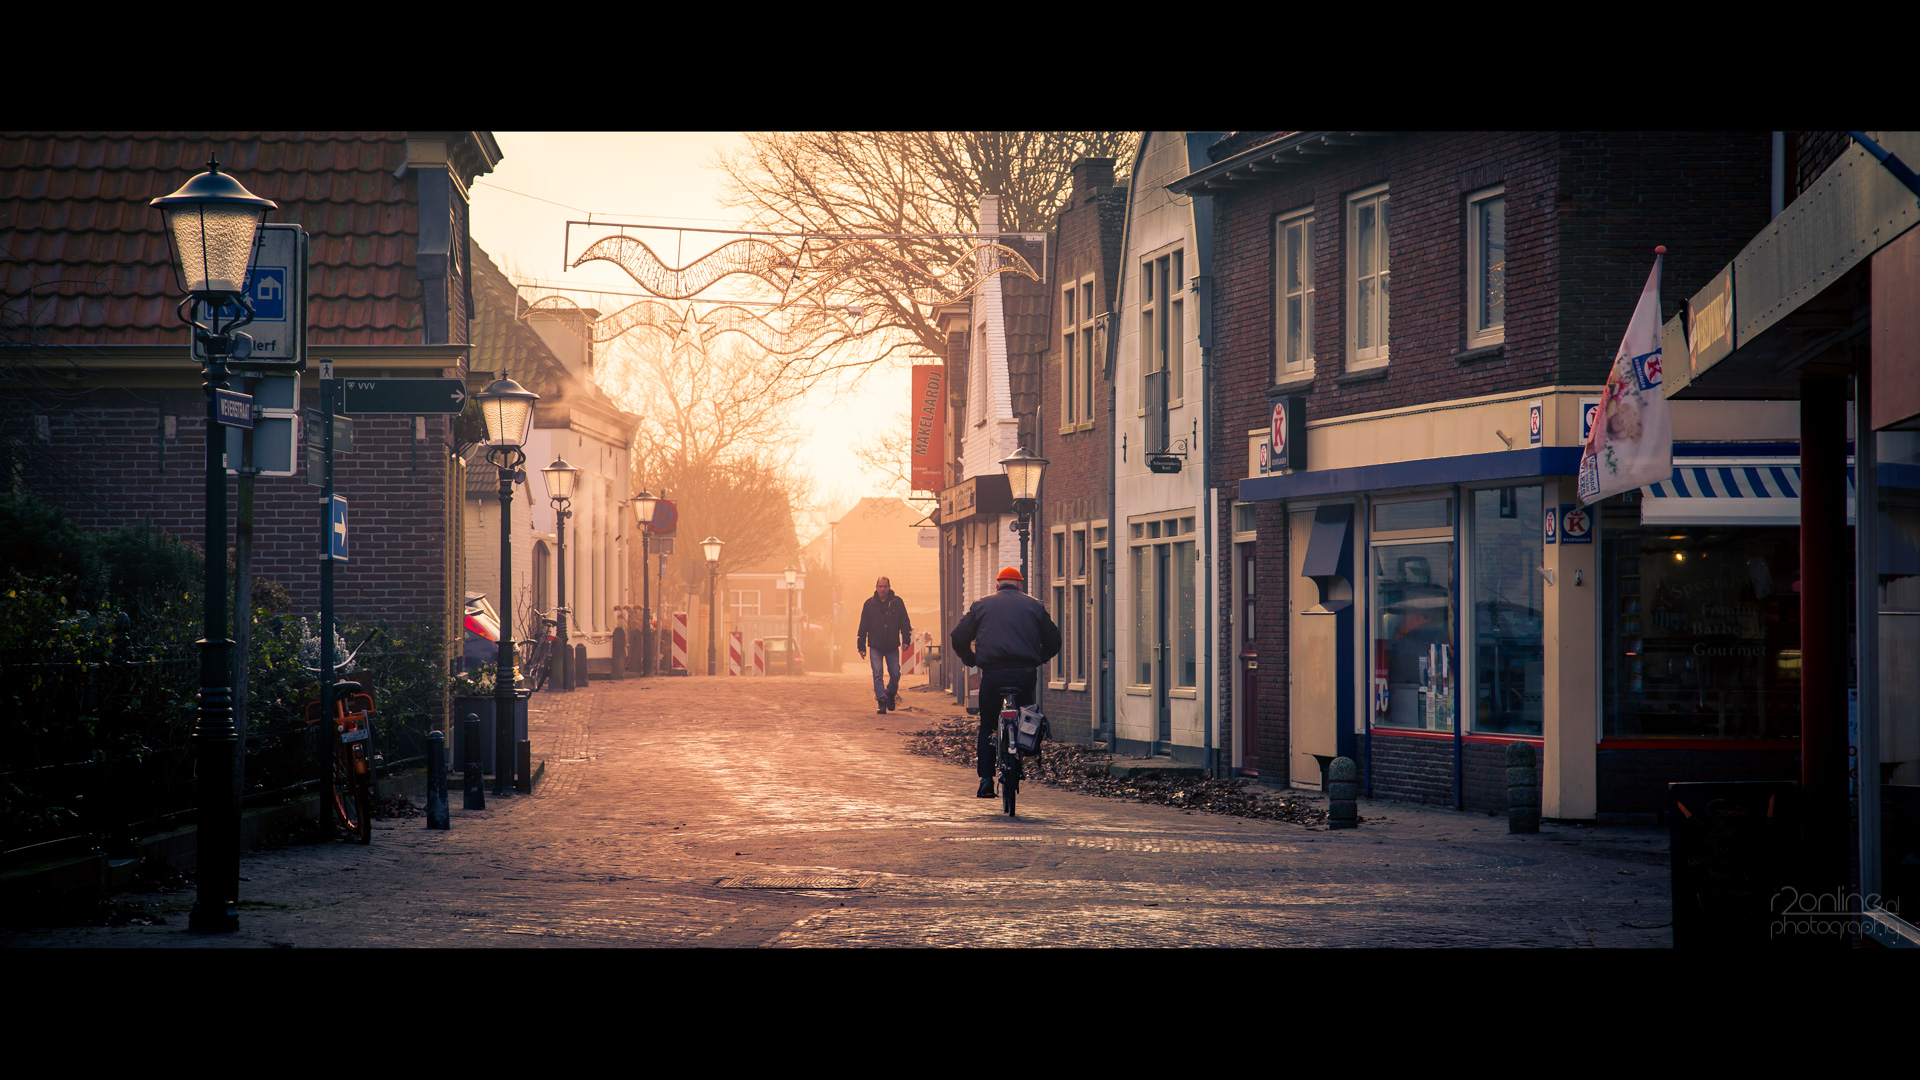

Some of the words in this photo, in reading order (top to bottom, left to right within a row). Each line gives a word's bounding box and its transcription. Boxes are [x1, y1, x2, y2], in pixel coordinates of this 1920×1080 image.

[358, 382, 376, 390] VVV
[220, 398, 250, 420] WEVERSTRAAT
[914, 371, 942, 456] MAKELAARDIJ
[1274, 416, 1284, 447] K
[1568, 517, 1585, 532] K
[1701, 602, 1761, 616] Fondue
[1692, 621, 1768, 636] Barbecue
[1692, 642, 1767, 657] Gourmet
